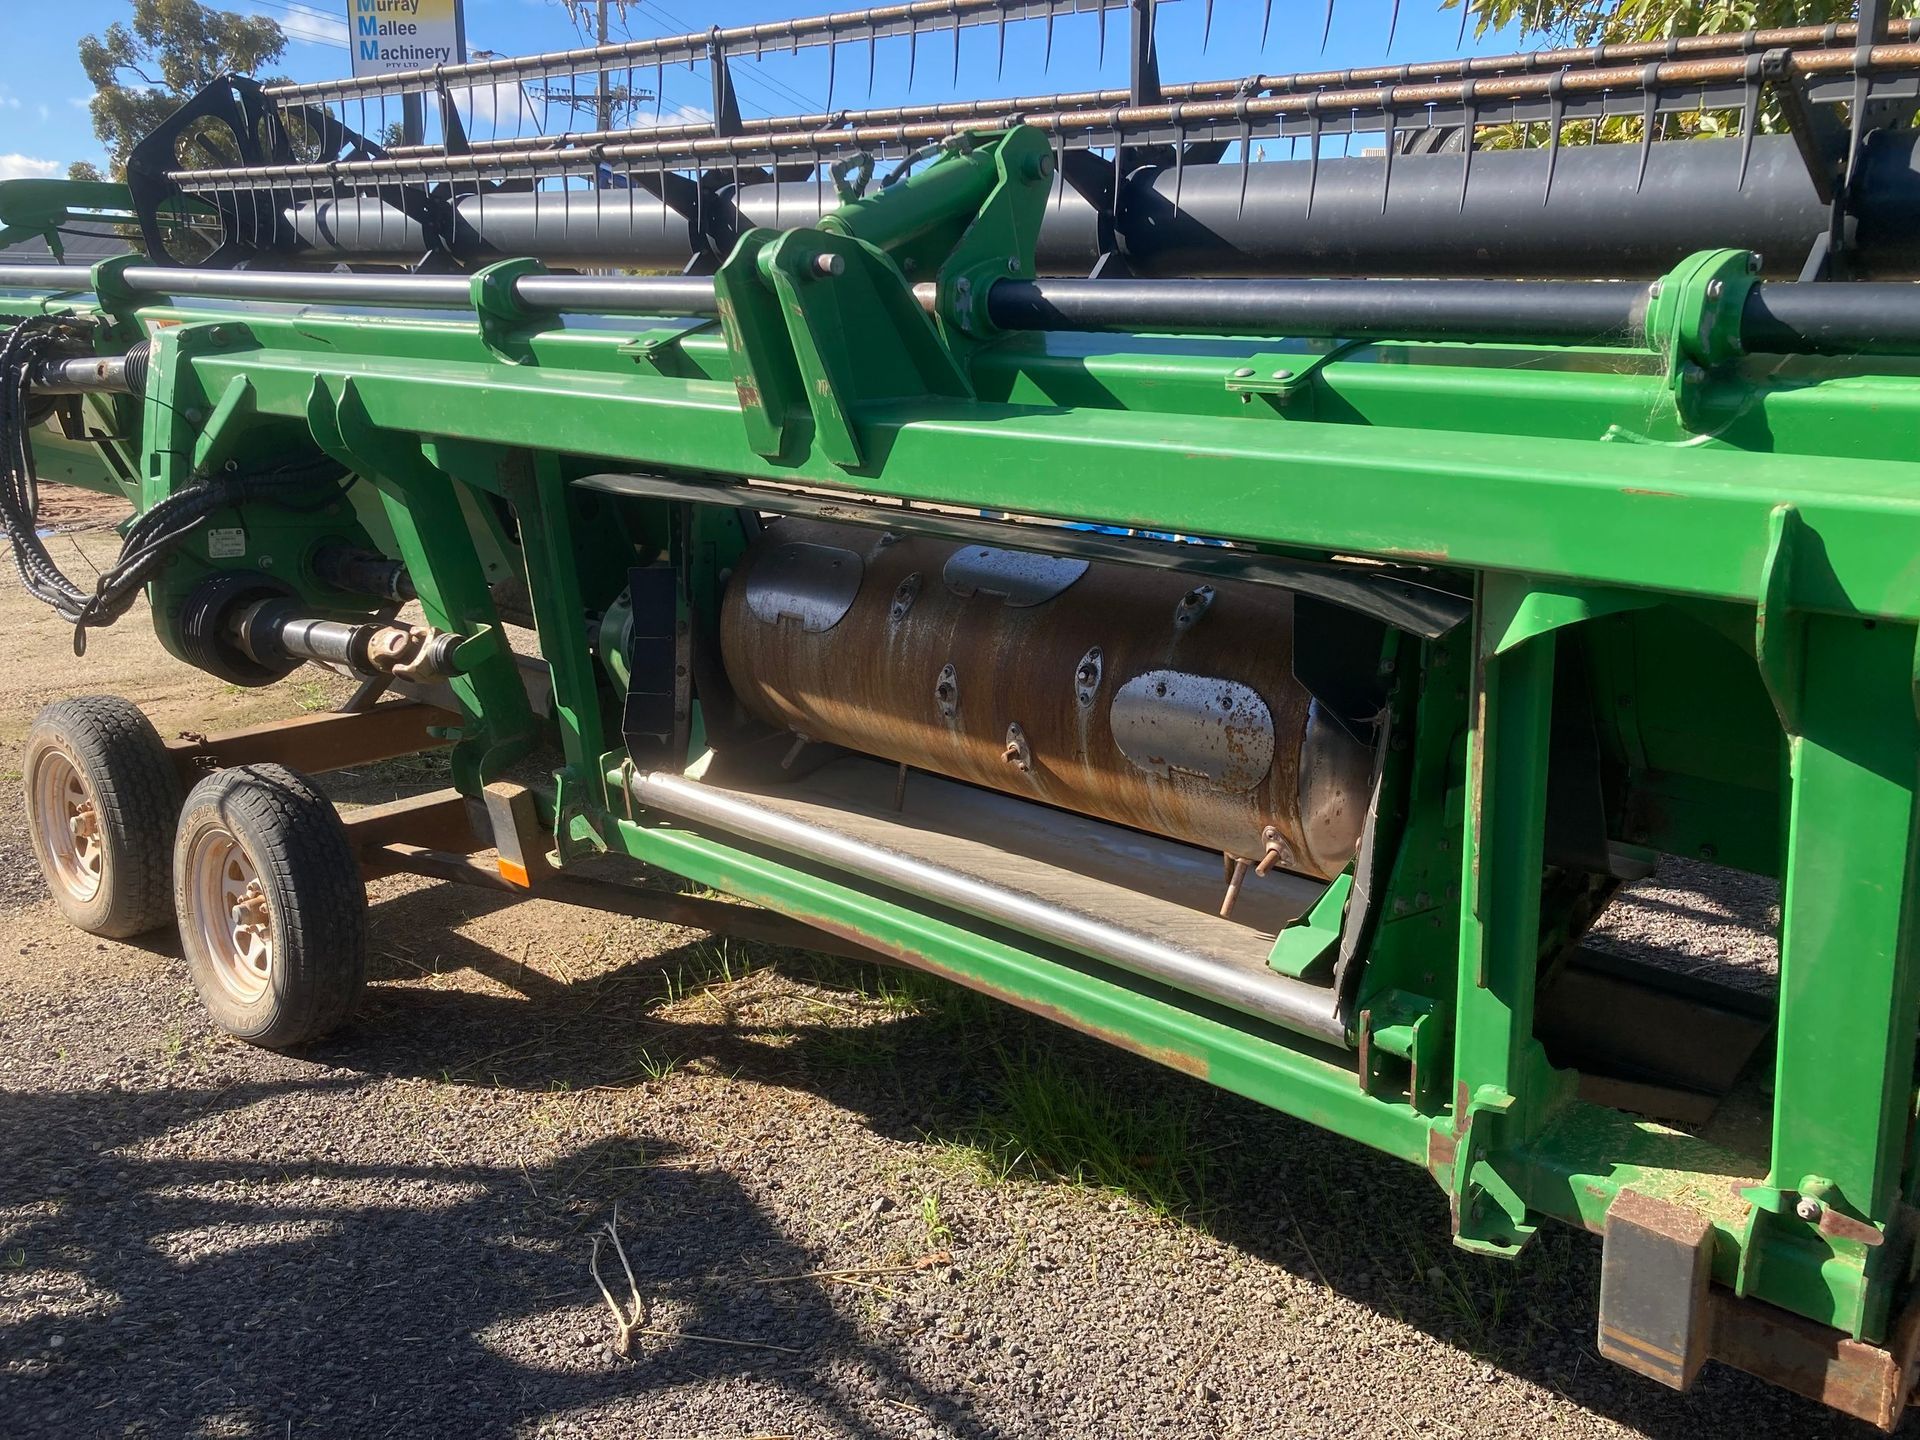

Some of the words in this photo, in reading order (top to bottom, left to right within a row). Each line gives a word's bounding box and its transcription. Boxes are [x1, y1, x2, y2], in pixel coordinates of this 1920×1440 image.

[357, 0, 419, 14] Murray
[358, 15, 417, 36] Mallee
[360, 40, 451, 62] Machinery
